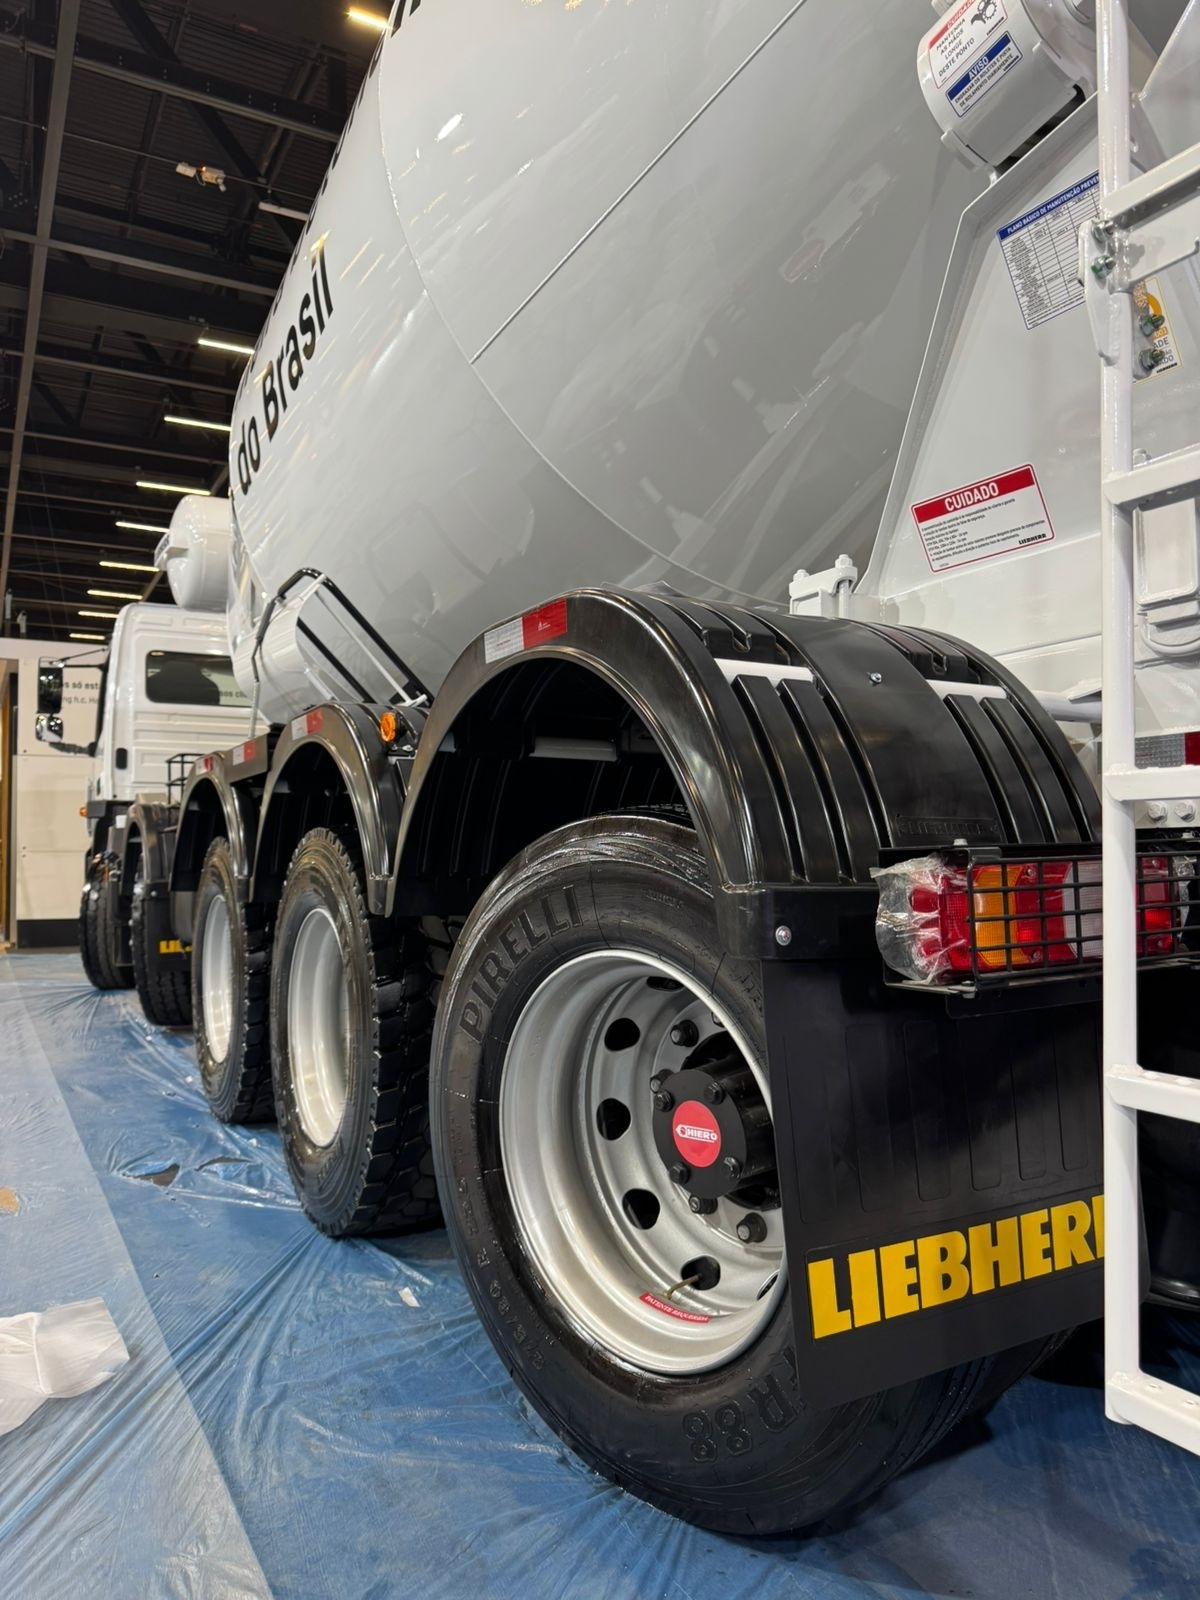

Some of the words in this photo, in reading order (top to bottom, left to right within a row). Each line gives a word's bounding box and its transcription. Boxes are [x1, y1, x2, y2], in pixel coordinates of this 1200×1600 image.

[938, 56, 956, 77] DESTE
[954, 36, 975, 59] PONTO
[967, 55, 989, 80] AVISO
[1006, 220, 1022, 234] PLANO
[1022, 208, 1039, 225] BÁSICO
[1040, 205, 1046, 214] DE
[1046, 184, 1080, 211] MANUTENÇÃO
[238, 416, 260, 496] do
[262, 248, 334, 442] Brasil
[944, 482, 999, 511] CUIDADO
[457, 884, 583, 1044] PIRELLI
